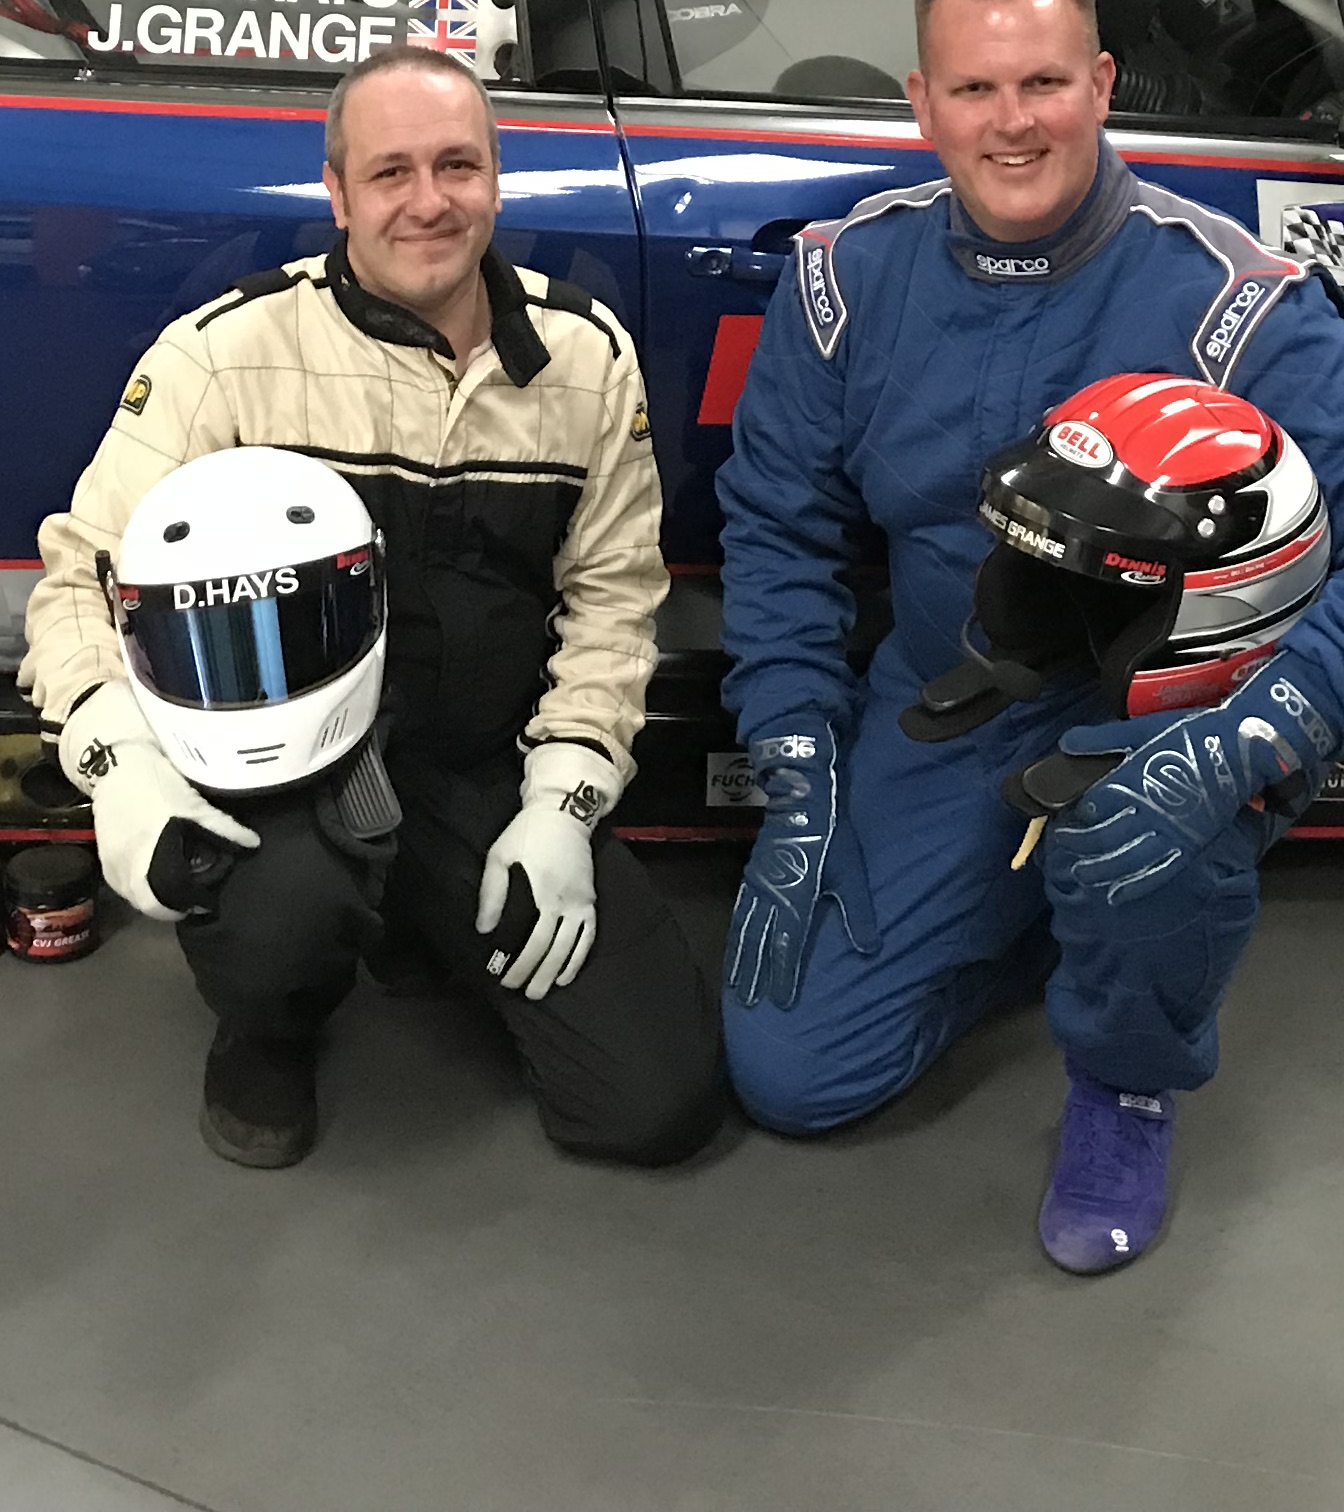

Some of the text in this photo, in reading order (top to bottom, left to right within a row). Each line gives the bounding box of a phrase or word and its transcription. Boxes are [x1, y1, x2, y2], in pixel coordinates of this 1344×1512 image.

[87, 3, 396, 62] J.GRANGE
[976, 253, 1051, 276] sparco
[807, 247, 834, 326] sparco
[1206, 281, 1264, 361] sparco
[1057, 425, 1101, 460] BELL
[1007, 522, 1066, 559] GRANGE
[173, 567, 299, 610] D.HAYS
[711, 774, 756, 788] FUCH
